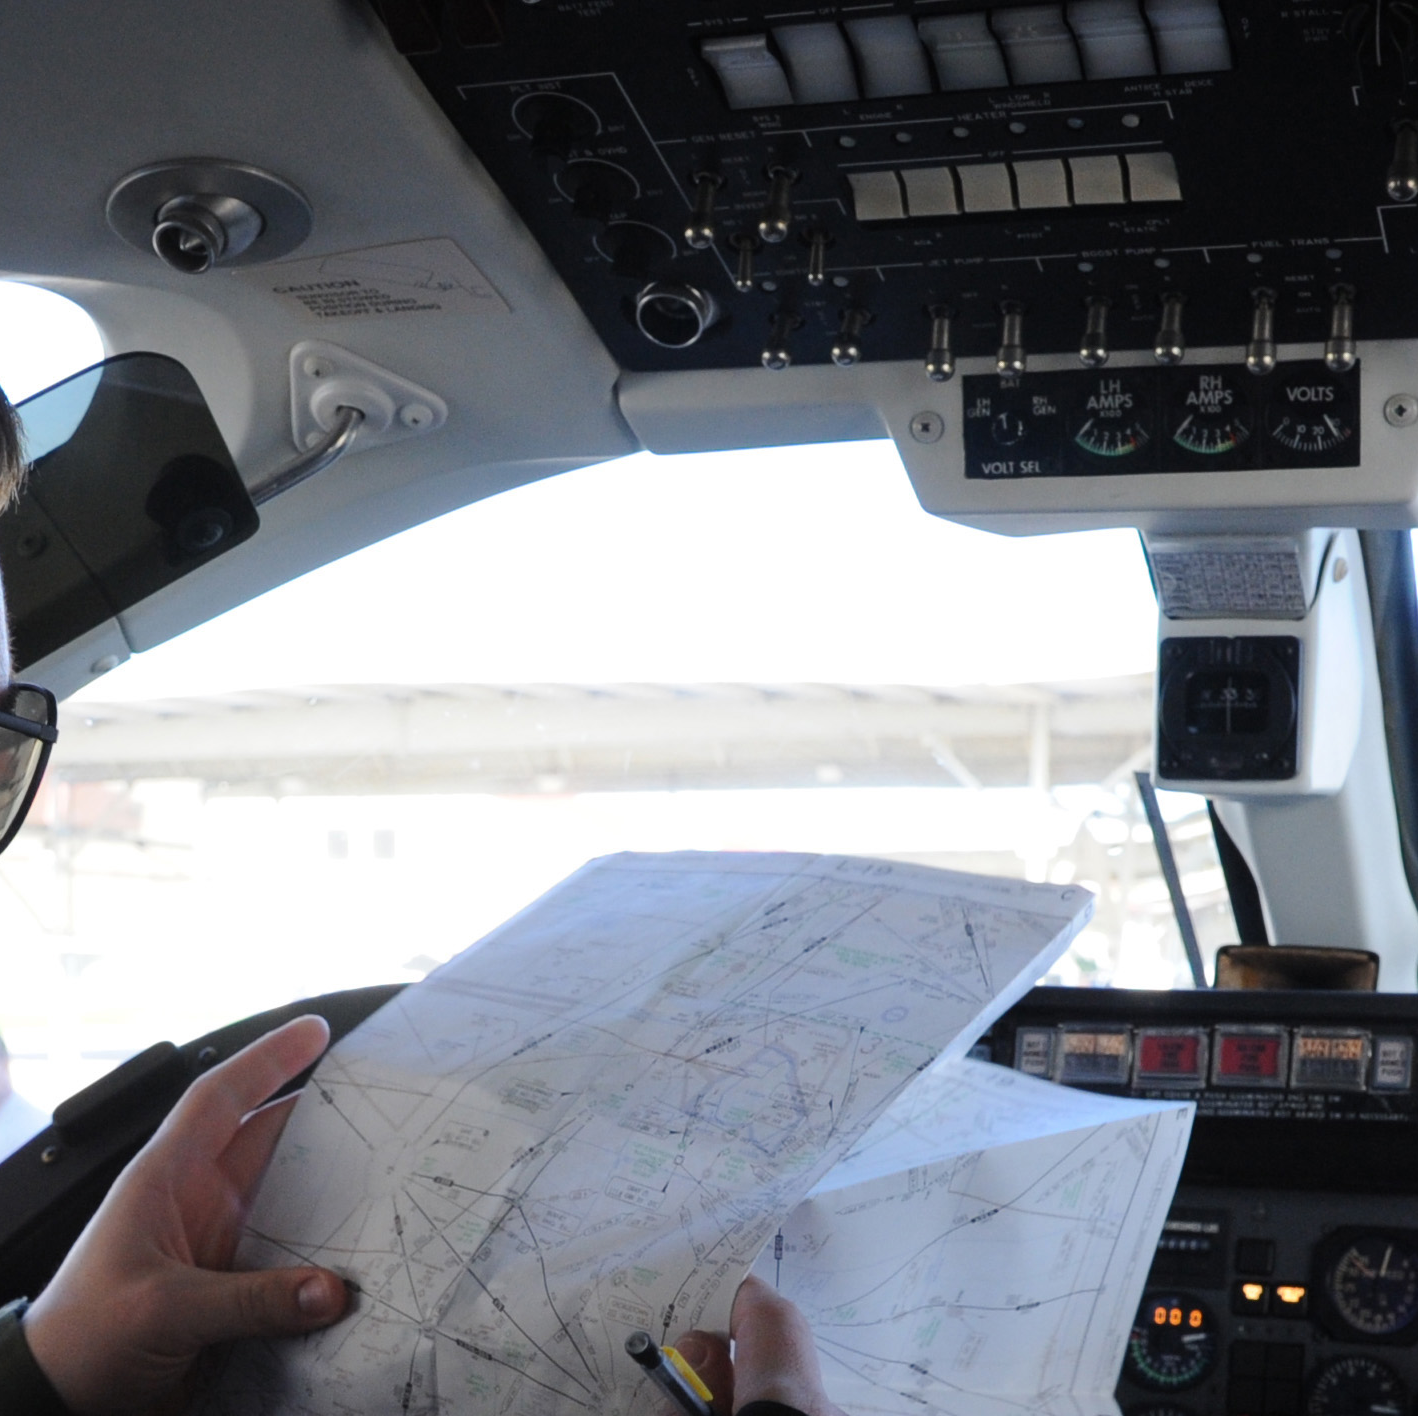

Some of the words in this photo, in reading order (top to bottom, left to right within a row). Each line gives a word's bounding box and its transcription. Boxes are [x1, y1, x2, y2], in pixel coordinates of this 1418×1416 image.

[1293, 8, 1331, 19] STALL
[859, 110, 894, 122] ENGINE
[956, 109, 1008, 123] HEATER
[691, 133, 715, 144] GEN
[718, 130, 757, 142] RESET
[1251, 239, 1284, 250] FUEL
[1290, 236, 1332, 248] TRANS
[1081, 248, 1120, 259] BOOST
[1125, 246, 1157, 257] PUMP
[953, 256, 985, 266] PUMP
[272, 279, 362, 294] CAUTION
[386, 302, 444, 314] LANDING
[999, 378, 1021, 390] BAT
[1099, 379, 1122, 394] LH
[1199, 375, 1223, 390] RH
[1032, 395, 1049, 406] RH
[1186, 390, 1233, 407] AMPS
[1286, 386, 1335, 402] VOLTS
[1086, 393, 1134, 411] AMPS
[967, 407, 992, 419] GEN
[1032, 405, 1058, 416] GEN
[981, 461, 1016, 476] VOLT
[1019, 460, 1042, 475] SEL
